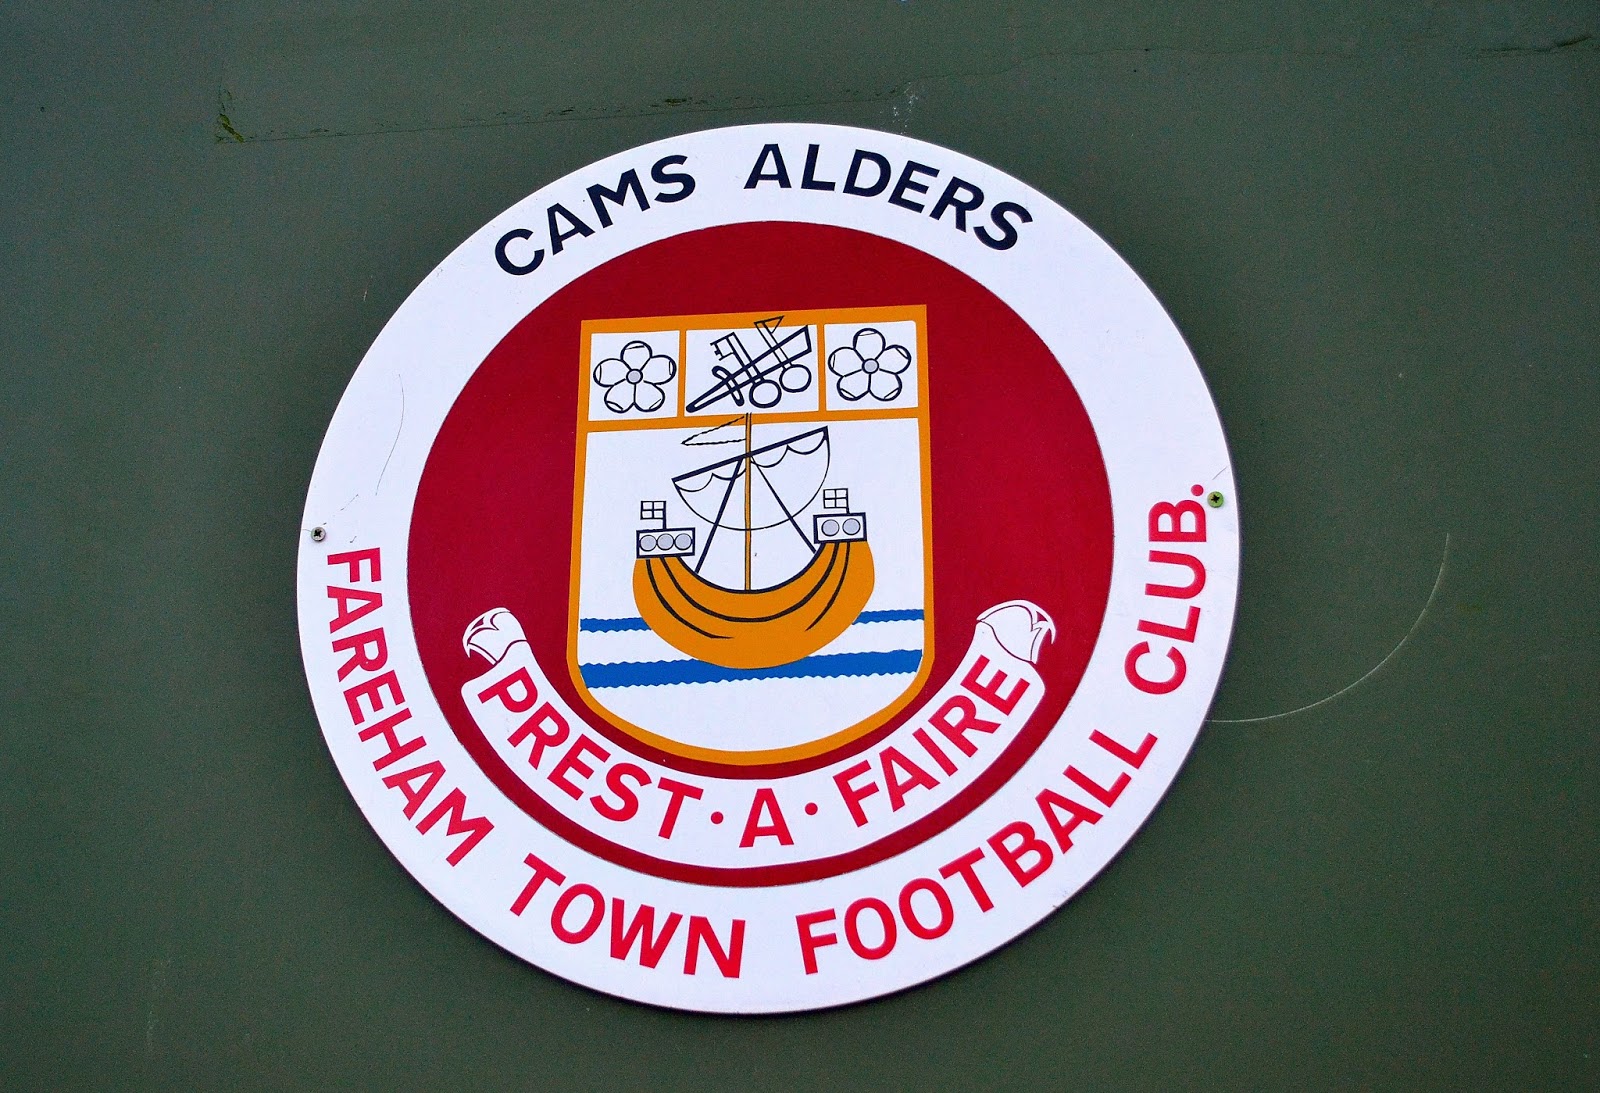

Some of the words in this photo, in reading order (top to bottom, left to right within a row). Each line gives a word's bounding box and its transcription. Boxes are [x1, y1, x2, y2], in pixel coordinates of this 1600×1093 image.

[493, 154, 696, 276] CAMS
[743, 143, 1034, 251] ALDERS
[327, 547, 495, 867] FAREHAM
[509, 852, 746, 979] TOWN
[795, 729, 1158, 975] FOOTBALL
[477, 666, 704, 840] PREST
[832, 654, 1031, 828] FAIRE
